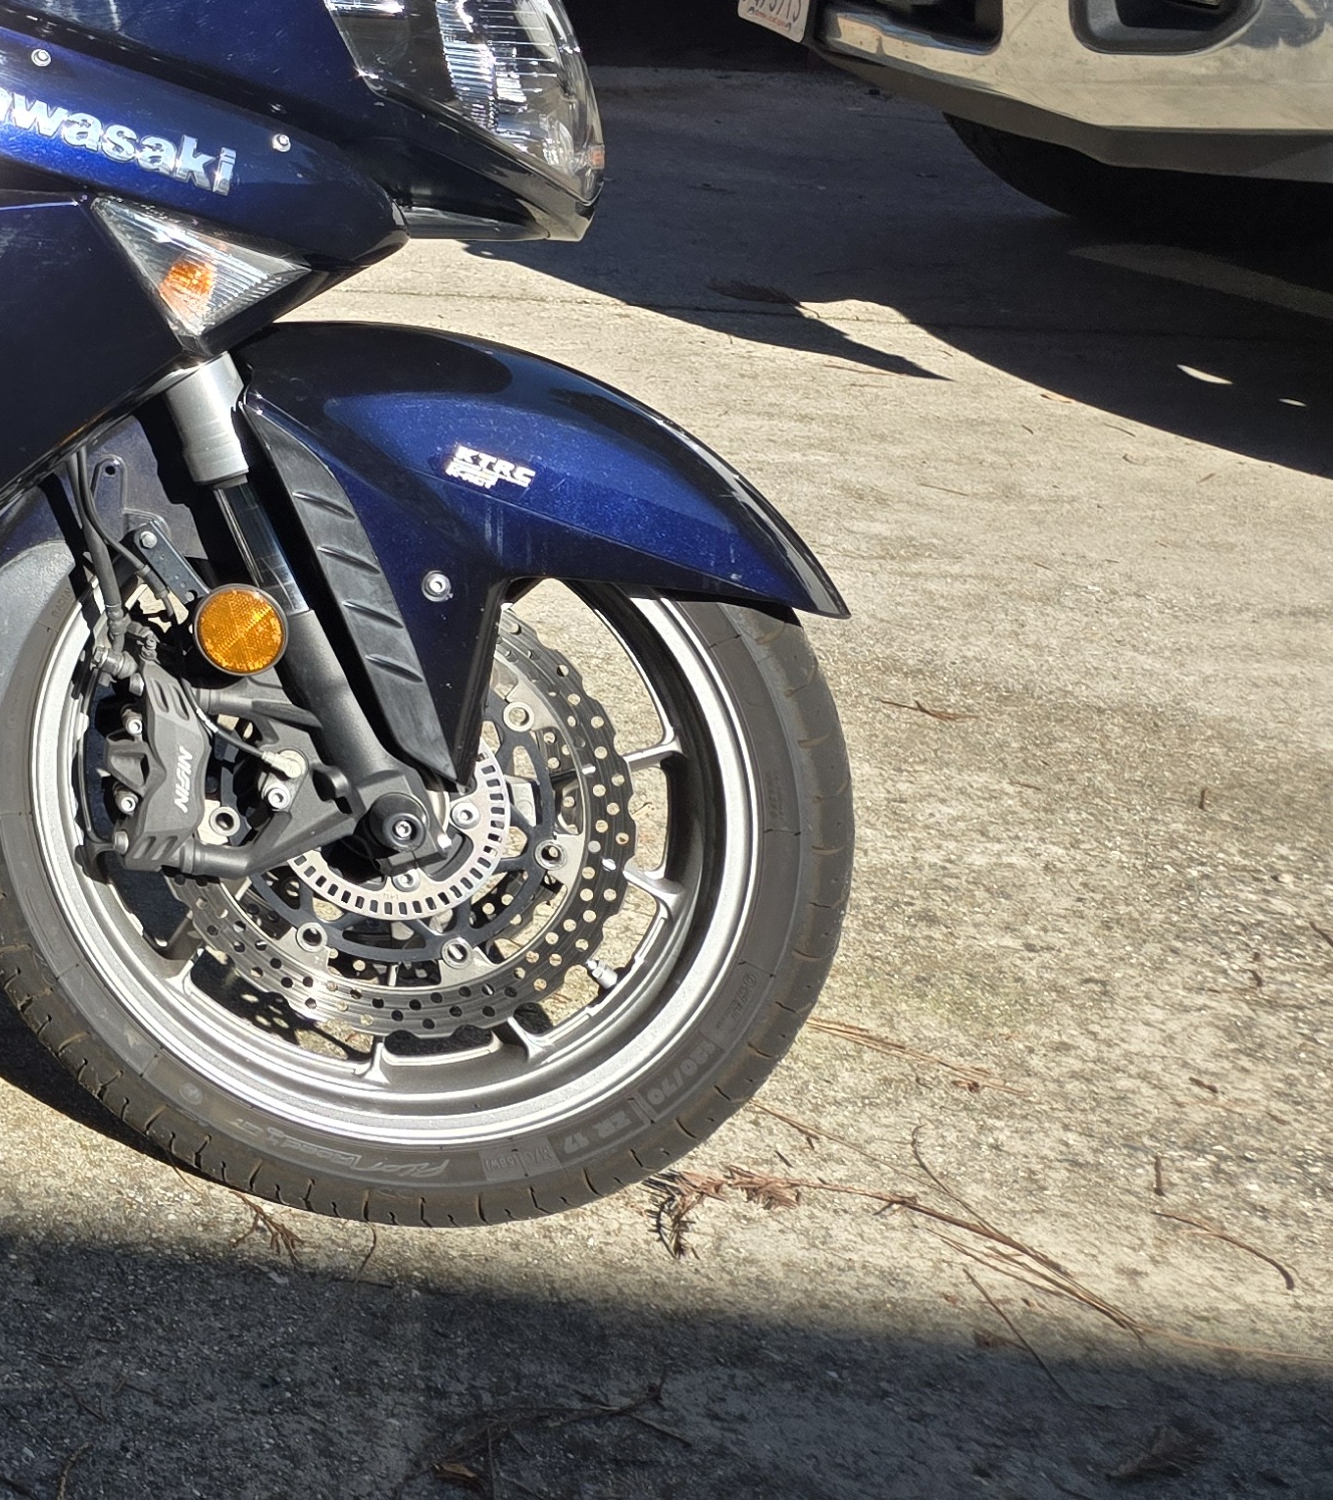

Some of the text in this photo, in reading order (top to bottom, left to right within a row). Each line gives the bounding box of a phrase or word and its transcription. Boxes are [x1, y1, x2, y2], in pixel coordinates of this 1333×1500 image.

[174, 745, 193, 814] NISSIN
[646, 1040, 718, 1105] 120/70
[562, 1132, 590, 1154] 17
[592, 1110, 632, 1138] ZR
